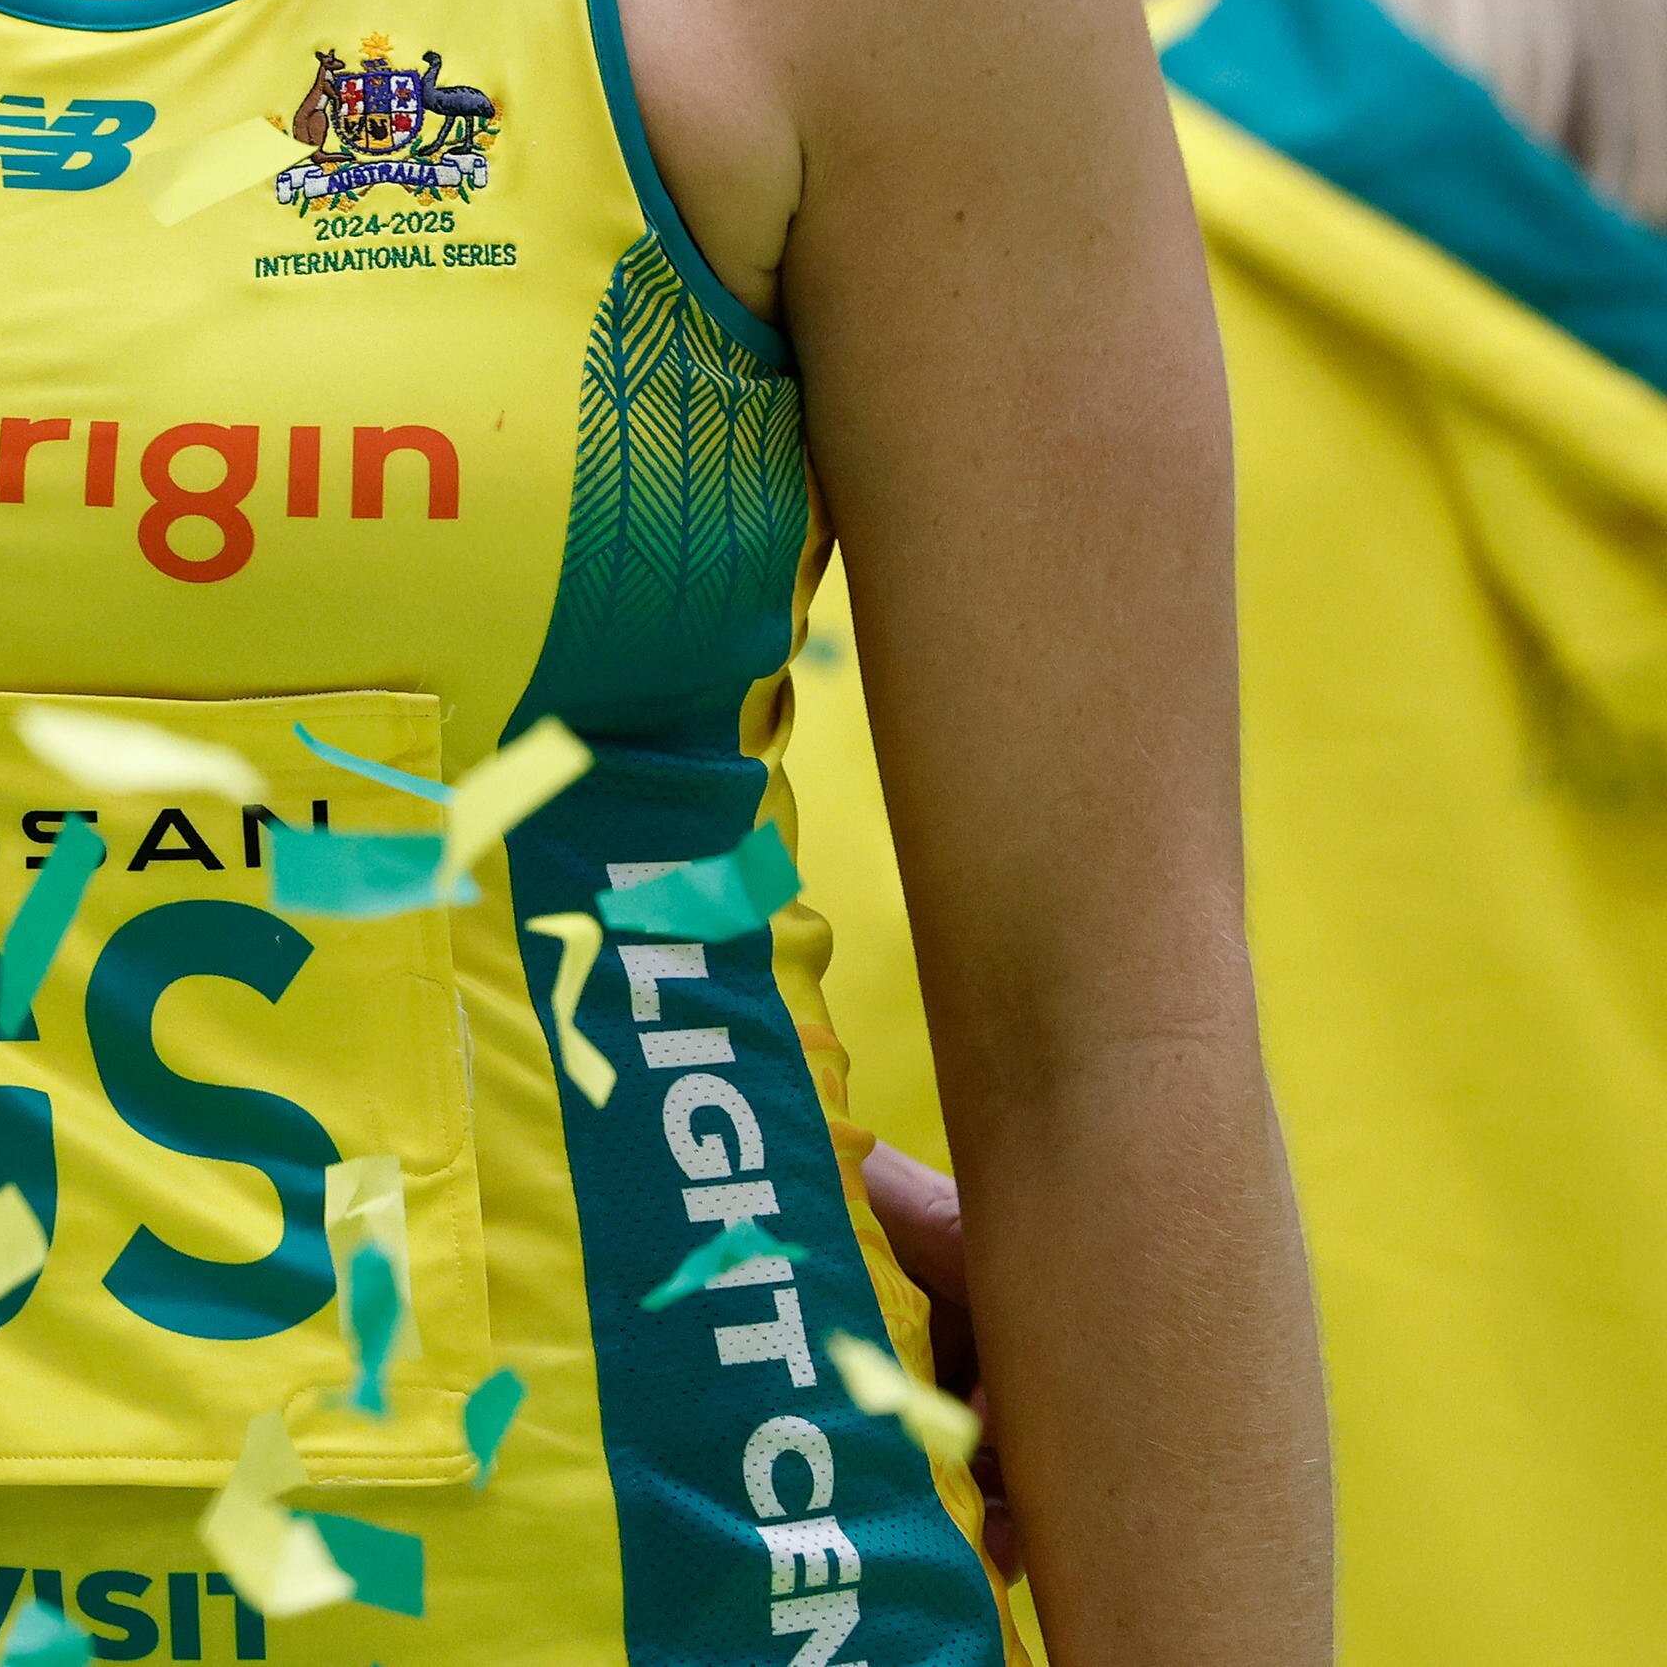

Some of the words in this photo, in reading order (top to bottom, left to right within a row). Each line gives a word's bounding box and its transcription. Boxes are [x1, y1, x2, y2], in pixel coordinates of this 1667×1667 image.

[327, 161, 439, 194] AUSTRALIA
[314, 211, 455, 241] 2024-2025
[254, 246, 436, 278] INTERNATIONAL
[442, 243, 517, 268] SERIES
